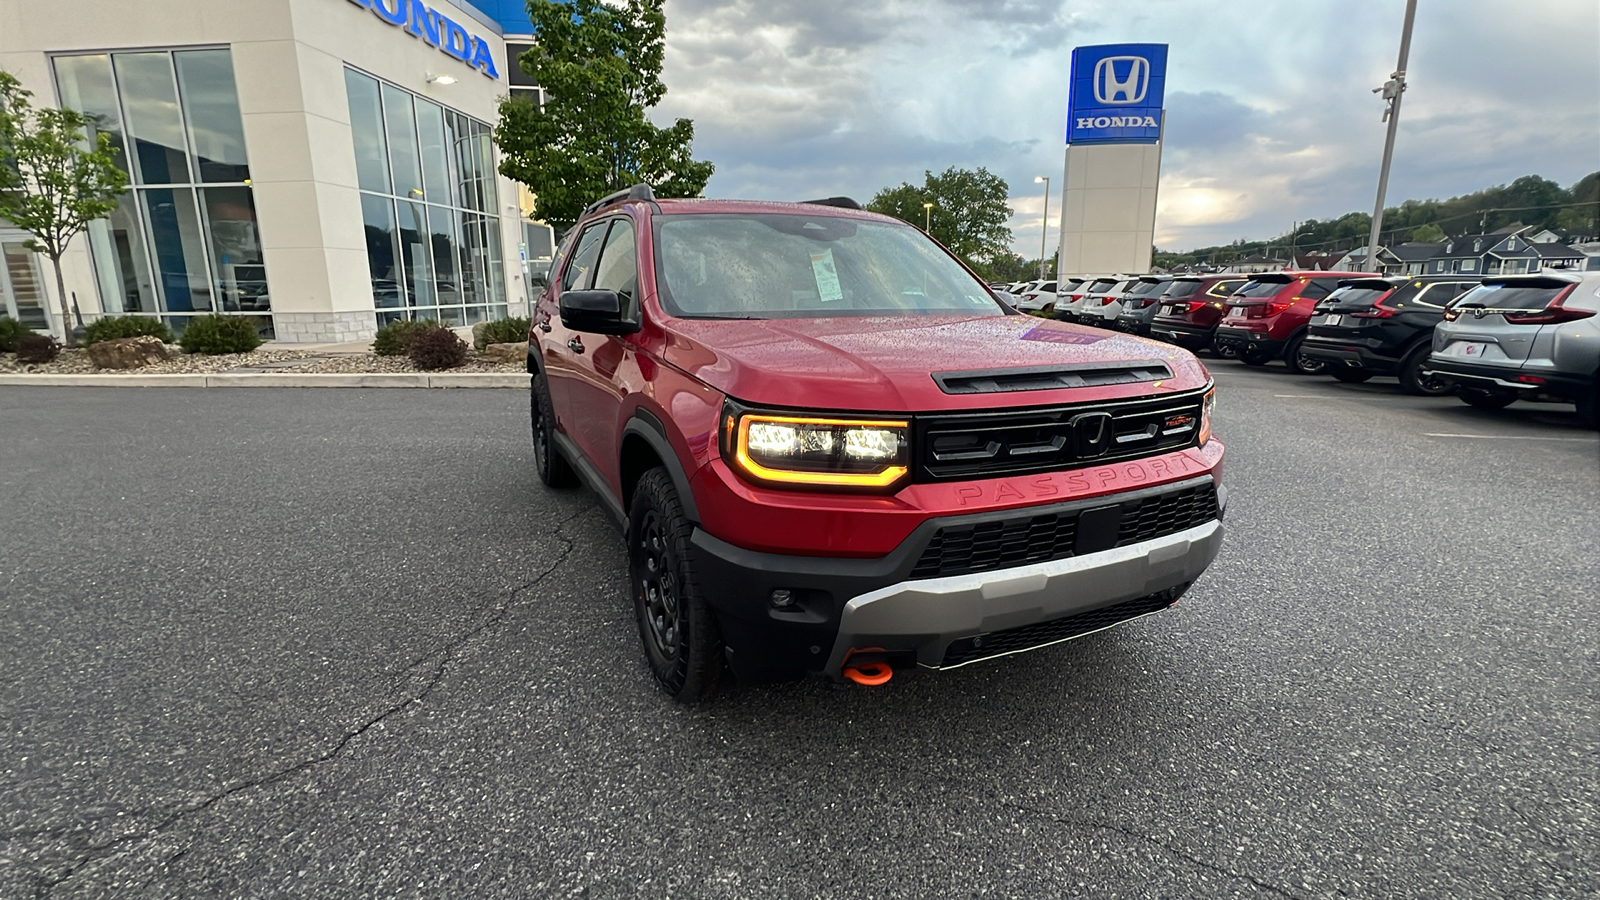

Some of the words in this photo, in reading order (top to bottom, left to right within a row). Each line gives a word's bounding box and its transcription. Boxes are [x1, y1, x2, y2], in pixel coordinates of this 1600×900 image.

[354, 0, 499, 79] ONDA
[1076, 116, 1158, 129] HONDA
[954, 452, 1189, 506] PASSPORT
